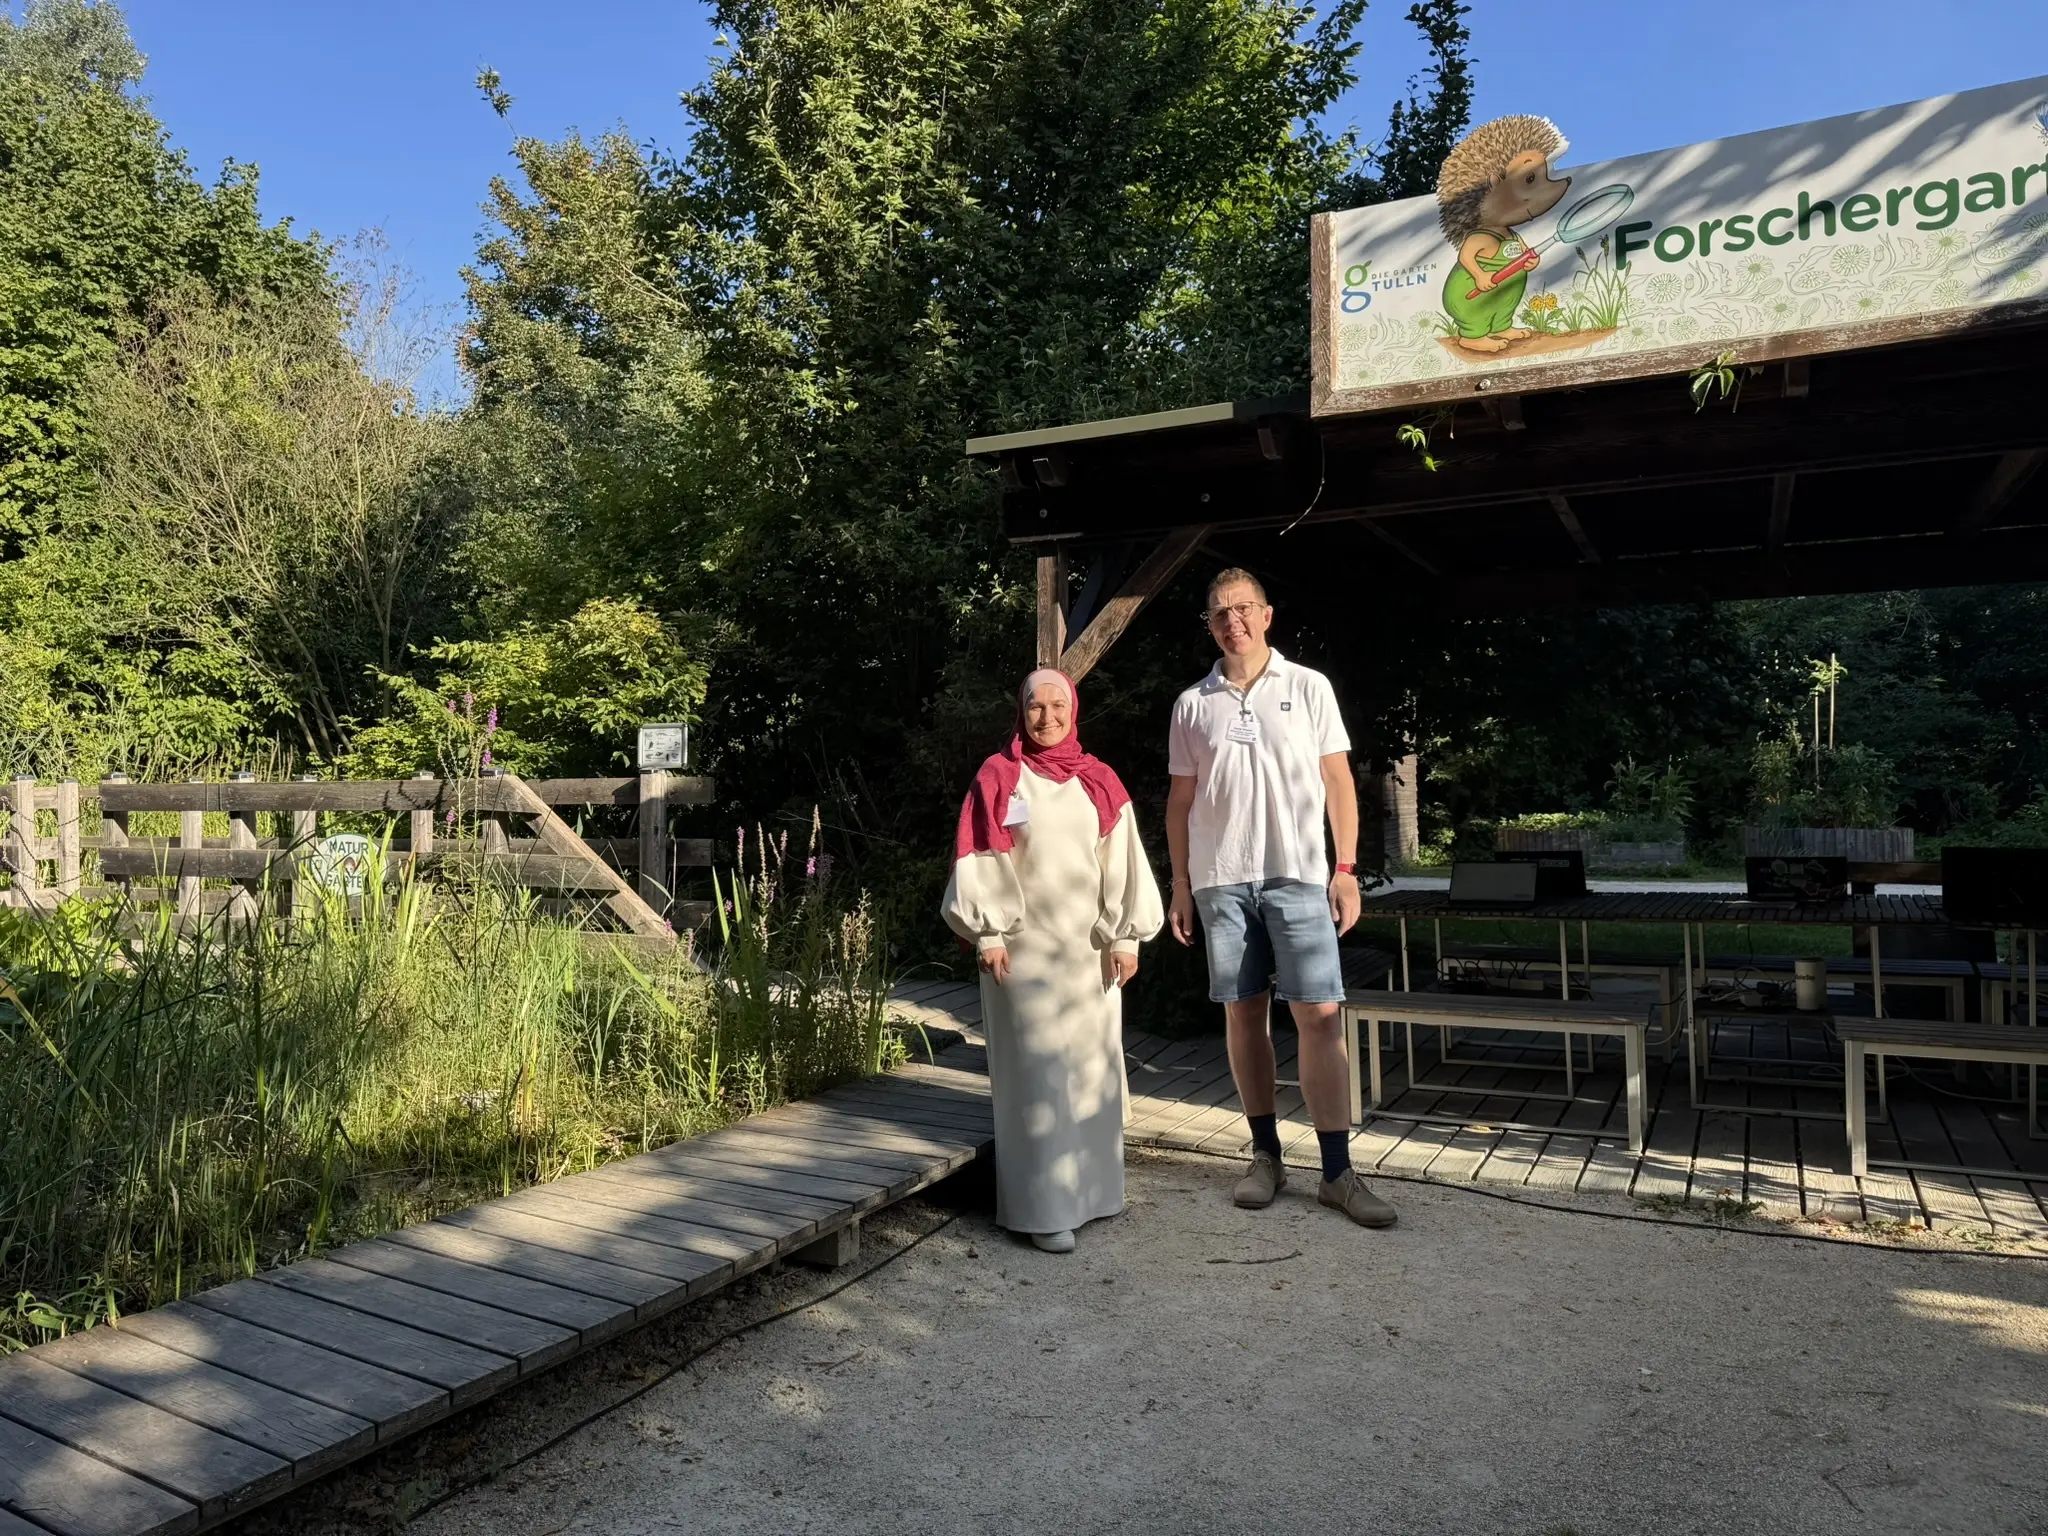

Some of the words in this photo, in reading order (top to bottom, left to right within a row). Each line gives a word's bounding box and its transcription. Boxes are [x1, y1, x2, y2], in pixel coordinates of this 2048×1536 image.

[1615, 153, 2048, 270] Forschergar
[1371, 271, 1389, 280] DIE
[1393, 263, 1437, 277] GARTEN
[1372, 273, 1427, 291] TULLN
[329, 840, 369, 855] NATUR
[326, 874, 363, 889] GARTE
